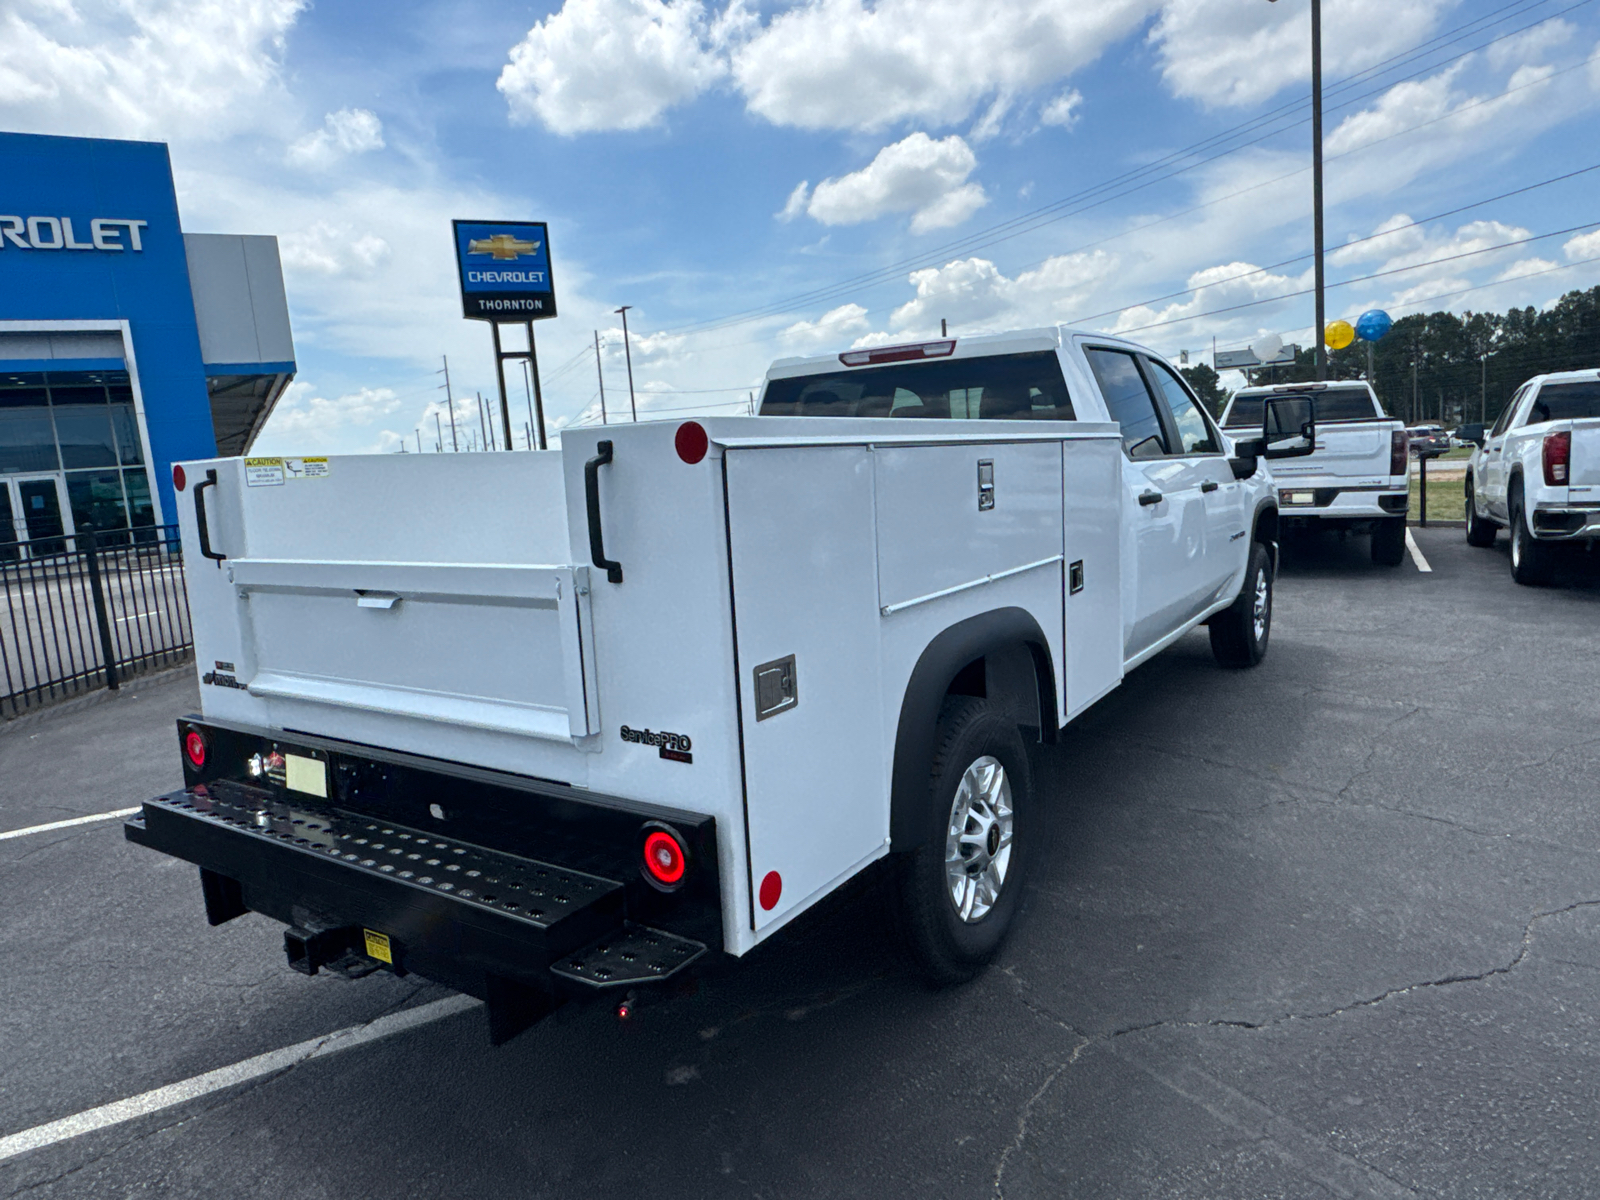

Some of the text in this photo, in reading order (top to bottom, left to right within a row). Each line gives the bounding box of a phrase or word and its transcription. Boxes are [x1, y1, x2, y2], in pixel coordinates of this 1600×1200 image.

[468, 271, 544, 283] CHEVROLET
[479, 299, 543, 310] THORNTON
[252, 458, 281, 466] CAUTION
[620, 725, 692, 752] ServicePRO
